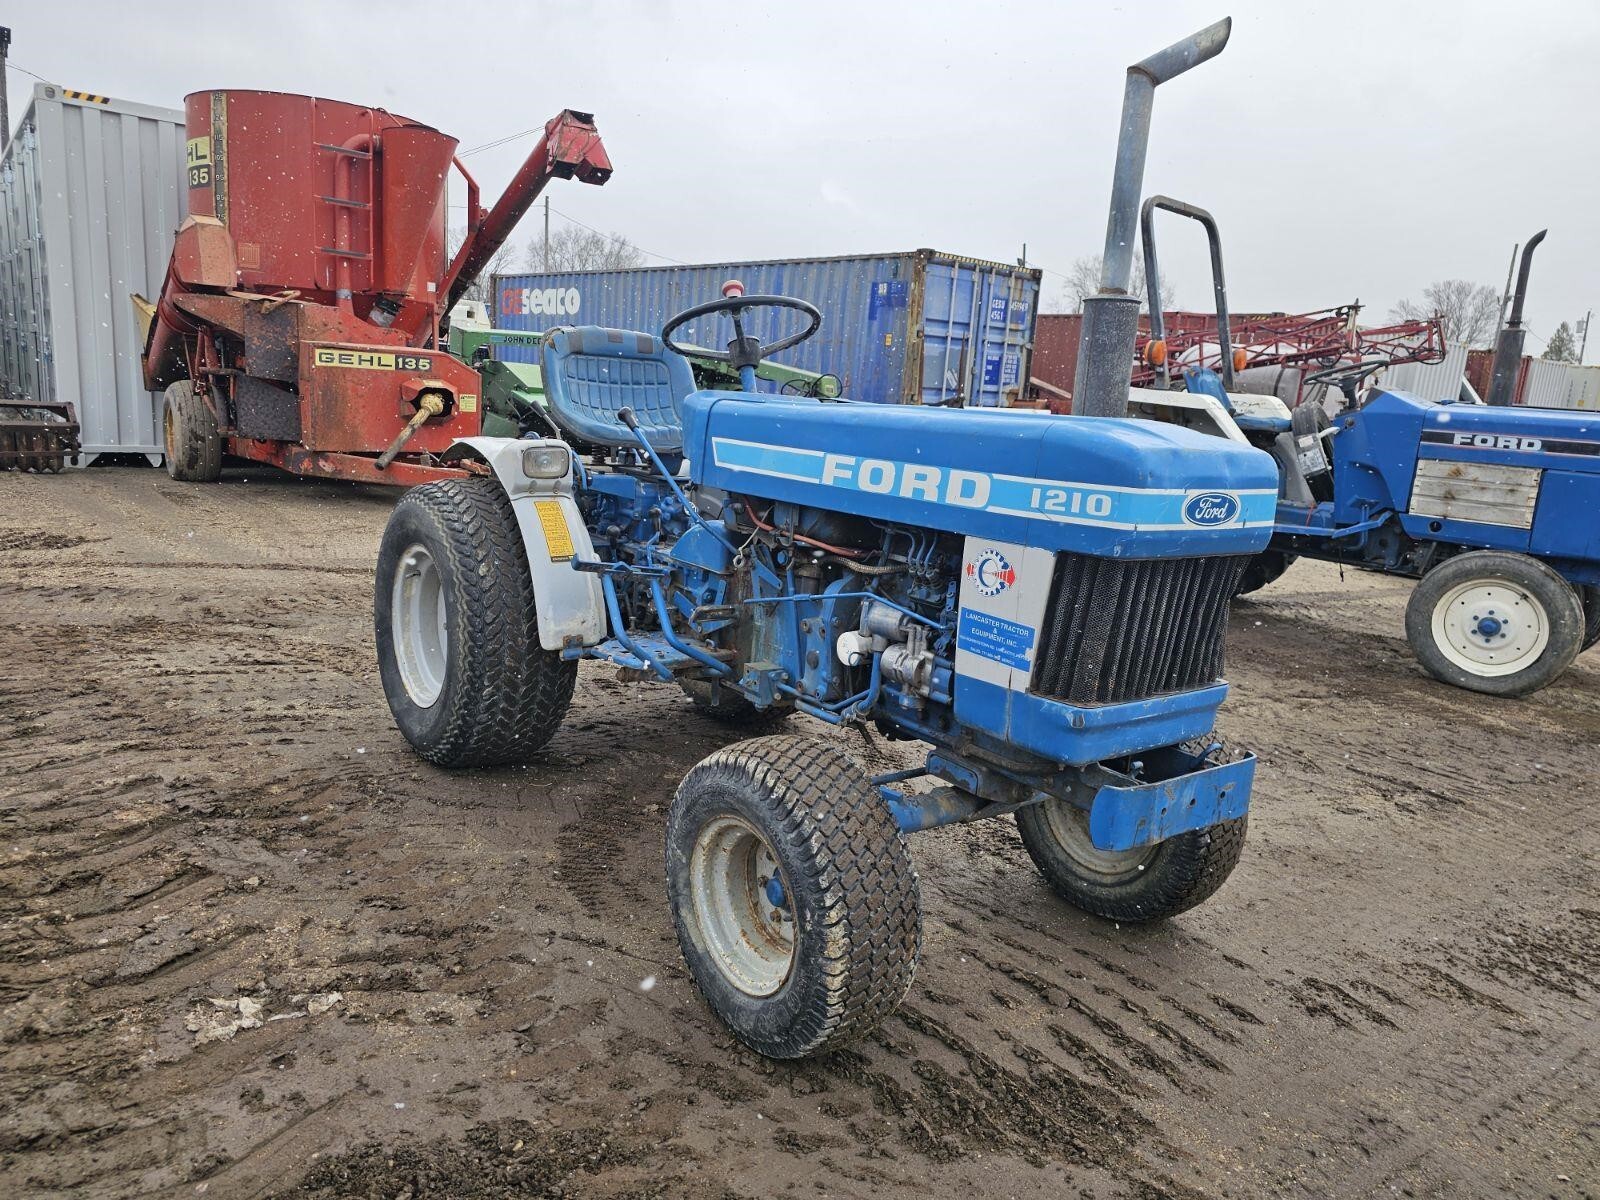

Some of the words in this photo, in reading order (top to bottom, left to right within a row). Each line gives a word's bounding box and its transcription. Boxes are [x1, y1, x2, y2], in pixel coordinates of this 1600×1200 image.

[187, 142, 208, 163] HL
[189, 168, 209, 186] 135
[503, 335, 524, 344] JOHN
[526, 337, 542, 345] DEE
[318, 351, 393, 368] GEHL
[397, 357, 431, 371] 135
[1453, 433, 1542, 451] FORD
[821, 453, 991, 508] FORD
[1030, 487, 1112, 517] 1210
[1195, 497, 1229, 519] Ford
[965, 611, 1000, 628] LANCASTER
[1001, 622, 1029, 637] TRACTOR
